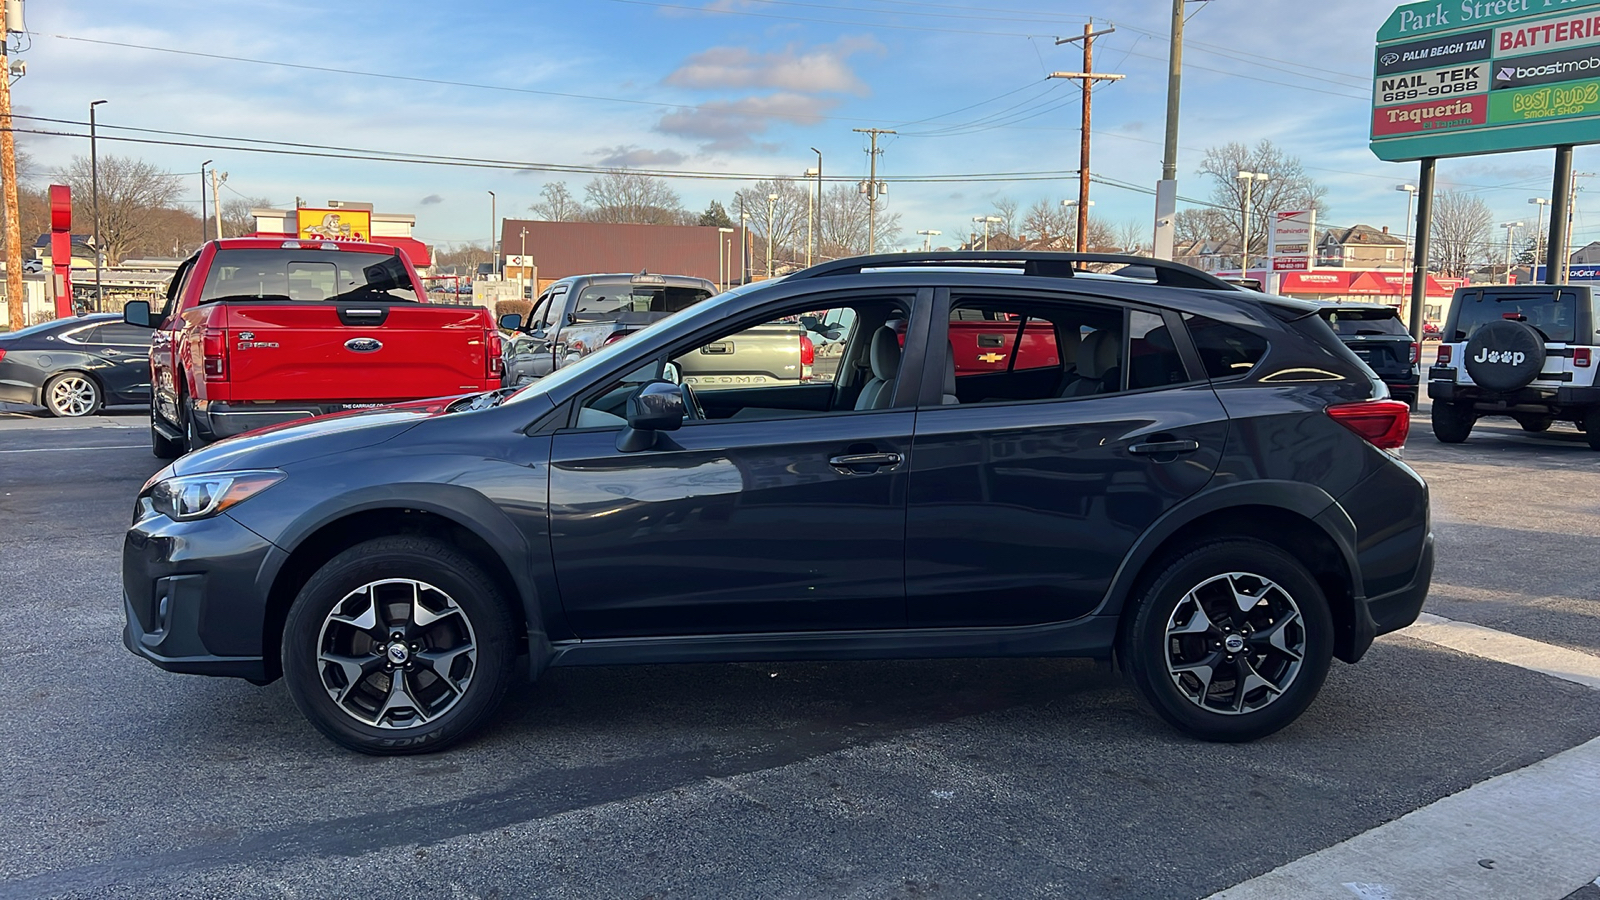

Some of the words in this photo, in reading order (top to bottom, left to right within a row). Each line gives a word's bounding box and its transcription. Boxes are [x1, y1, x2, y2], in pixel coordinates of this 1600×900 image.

[1399, 3, 1449, 33] Park
[1461, 0, 1530, 21] Street
[1402, 48, 1429, 61] PALM
[1430, 42, 1464, 57] BEACH
[1466, 39, 1487, 51] TAN
[1382, 75, 1427, 92] NAIL
[1436, 66, 1480, 84] TEK
[1383, 81, 1478, 102] 689-9088
[1524, 108, 1556, 119] SMOKE
[1557, 105, 1585, 116] SHOP
[684, 376, 767, 384] ACOMA
